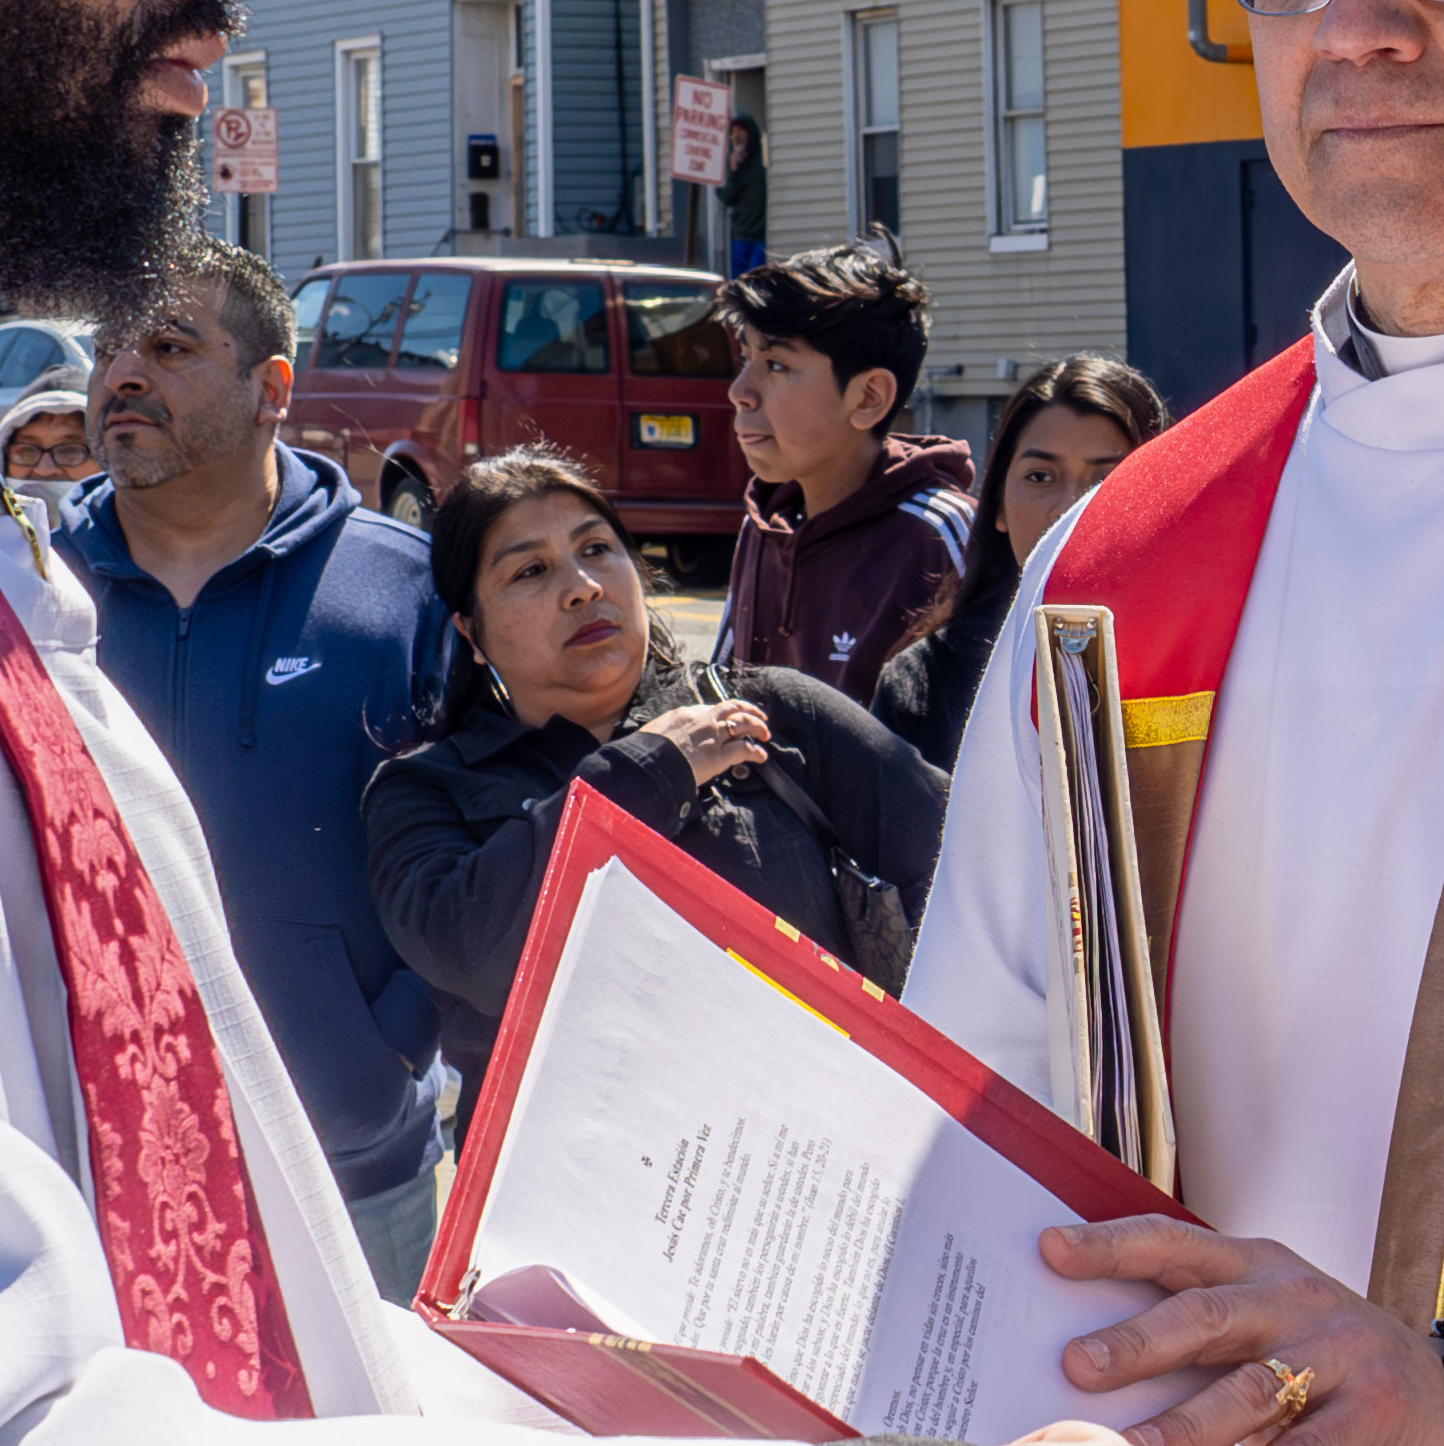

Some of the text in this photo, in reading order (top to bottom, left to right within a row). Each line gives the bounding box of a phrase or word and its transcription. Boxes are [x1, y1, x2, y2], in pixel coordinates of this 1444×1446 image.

[275, 657, 309, 672] NIKE
[786, 1140, 800, 1158] han
[814, 1137, 834, 1169] 20-21)
[654, 1138, 689, 1224] Tercera Estación
[662, 1123, 712, 1263] Jesús Cae por Primera Vez
[842, 1169, 853, 1192] para
[804, 1183, 818, 1209] (Juan
[833, 1189, 847, 1221] mundo
[721, 1194, 739, 1235] redimiste
[764, 1263, 780, 1300] también
[775, 1218, 792, 1265] guardarán
[801, 1139, 815, 1161] Pero
[886, 1206, 903, 1246] Corintios
[759, 1210, 779, 1263] perseguirán
[827, 1219, 839, 1237] del
[716, 1235, 727, 1256] cruz
[731, 1270, 746, 1299] siervo
[747, 1227, 759, 1246] más
[753, 1208, 764, 1227] que
[822, 1236, 834, 1262] necio
[943, 1232, 954, 1252] más
[709, 1256, 721, 1280] santa
[752, 1261, 765, 1276] los
[805, 1357, 817, 1373] los
[820, 1294, 834, 1317] Dios
[833, 1242, 848, 1281] escogido
[844, 1206, 858, 1231] débil
[851, 1190, 862, 1208] del
[857, 1162, 870, 1193] mundo
[829, 1331, 839, 1350] que
[842, 1250, 861, 1288] También
[853, 1228, 867, 1251] Dios
[866, 1177, 880, 1215] escogido
[938, 1251, 949, 1271] sino
[964, 1257, 977, 1294] aquellos
[701, 1290, 711, 1311] por
[744, 1276, 761, 1313] también
[780, 1276, 793, 1303] causa
[808, 1272, 824, 1313] escogido
[775, 1302, 785, 1322] por
[865, 1292, 881, 1326] delante
[927, 1301, 938, 1316] sin
[959, 1293, 969, 1315] para
[693, 1308, 707, 1328] Que
[921, 1315, 935, 1340] vidas
[925, 1356, 939, 1392] porque
[936, 1325, 947, 1347] cruz
[946, 1252, 963, 1302] instrumento
[765, 1319, 780, 1346] harán
[795, 1326, 810, 1349] Dios
[862, 1325, 873, 1353] jacte
[761, 1346, 774, 1360] les
[793, 1348, 804, 1367] que
[945, 1282, 986, 1432] seguir Cristo por los caminos del
[947, 1351, 956, 1365] en
[851, 1360, 863, 1387] nadie
[912, 1352, 925, 1386] pensar
[846, 1386, 857, 1405] que
[933, 1374, 950, 1410] hombre
[929, 1409, 941, 1426] del
